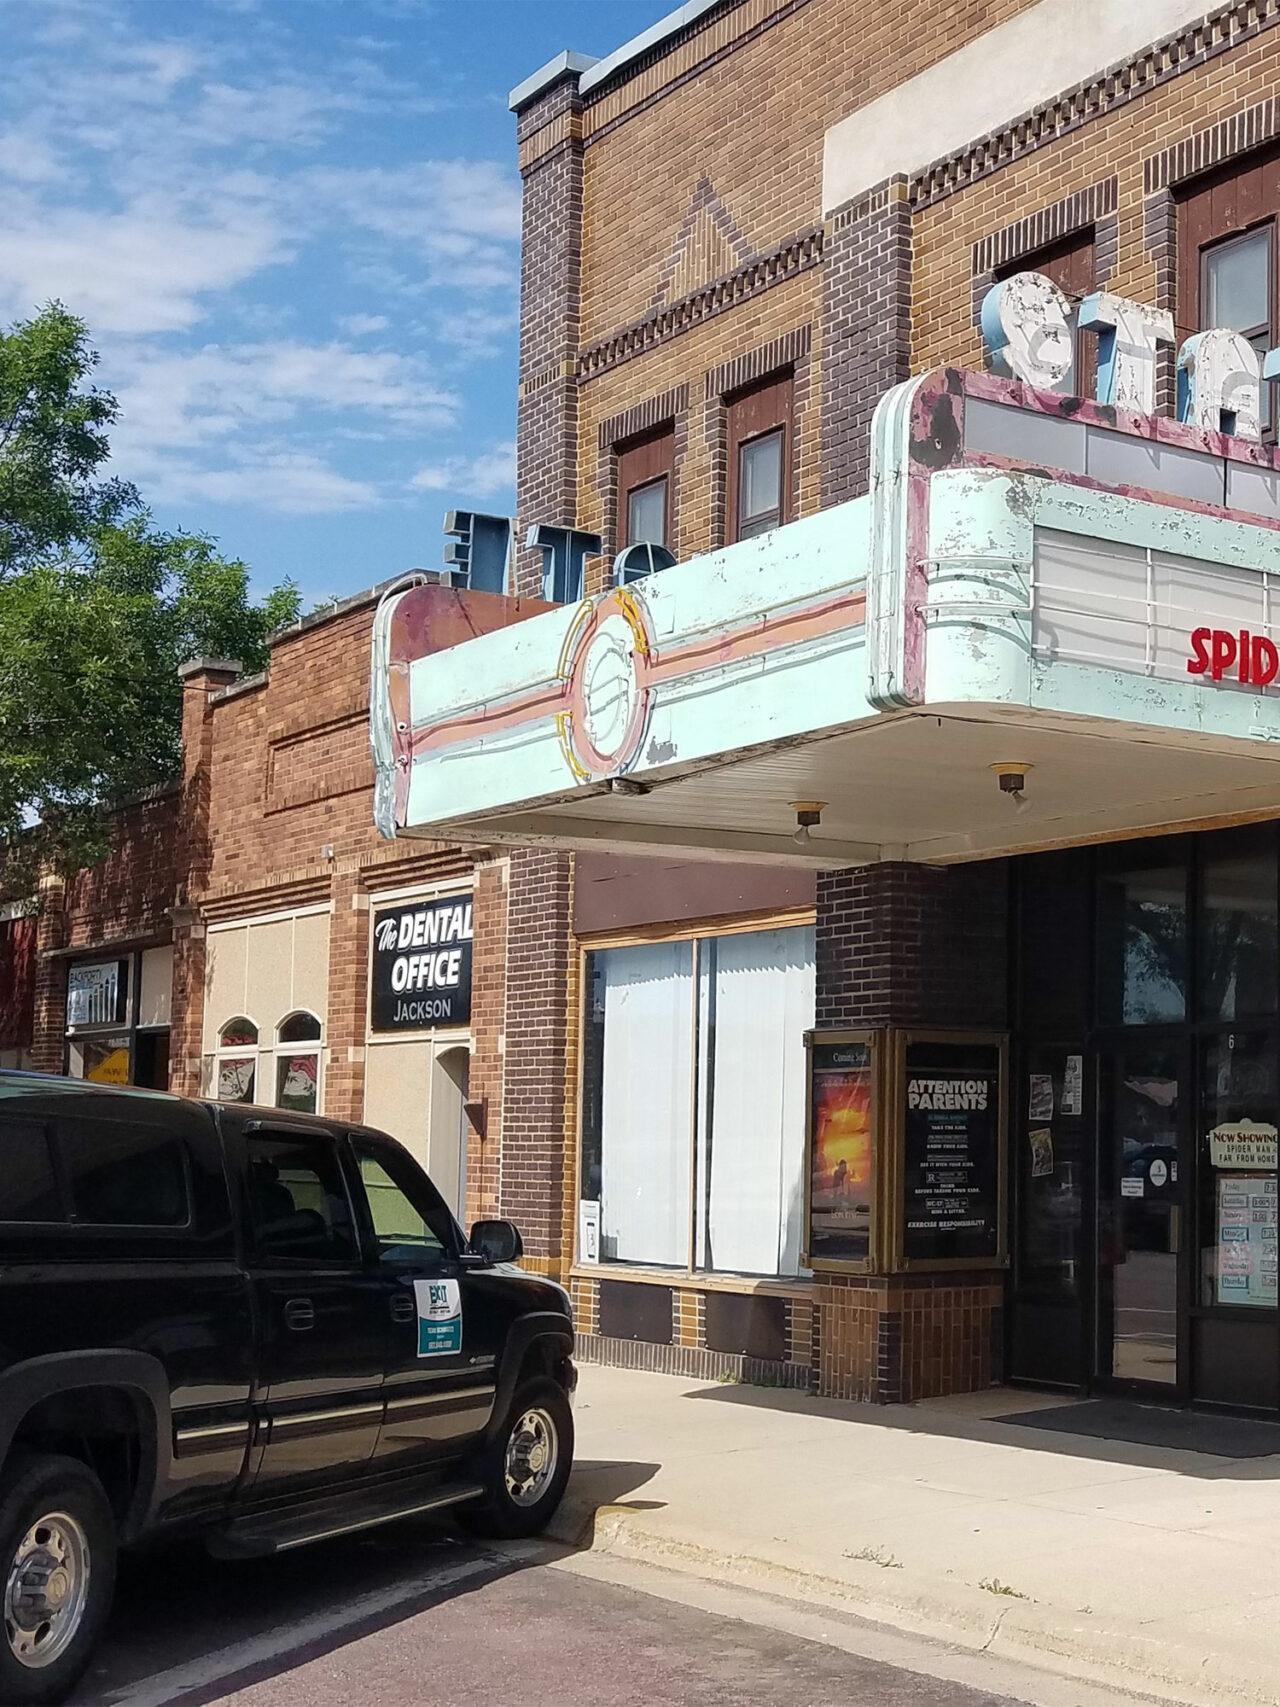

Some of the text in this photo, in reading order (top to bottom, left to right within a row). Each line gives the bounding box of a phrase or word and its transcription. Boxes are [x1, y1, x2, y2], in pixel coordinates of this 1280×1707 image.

[375, 903, 474, 952] The DENTAL
[391, 948, 462, 994] OFFICE
[393, 999, 451, 1021] JACKSON
[1228, 1034, 1235, 1049] 6
[908, 1080, 988, 1094] ATTENTION
[908, 1093, 988, 1110] PARENTS
[1213, 1132, 1278, 1144] NOW SHOWING
[1226, 1144, 1271, 1153] SPIDER MAN
[1219, 1154, 1276, 1164] FAR FROM HOME
[928, 1173, 936, 1182] R
[429, 1285, 448, 1305] EXIT
